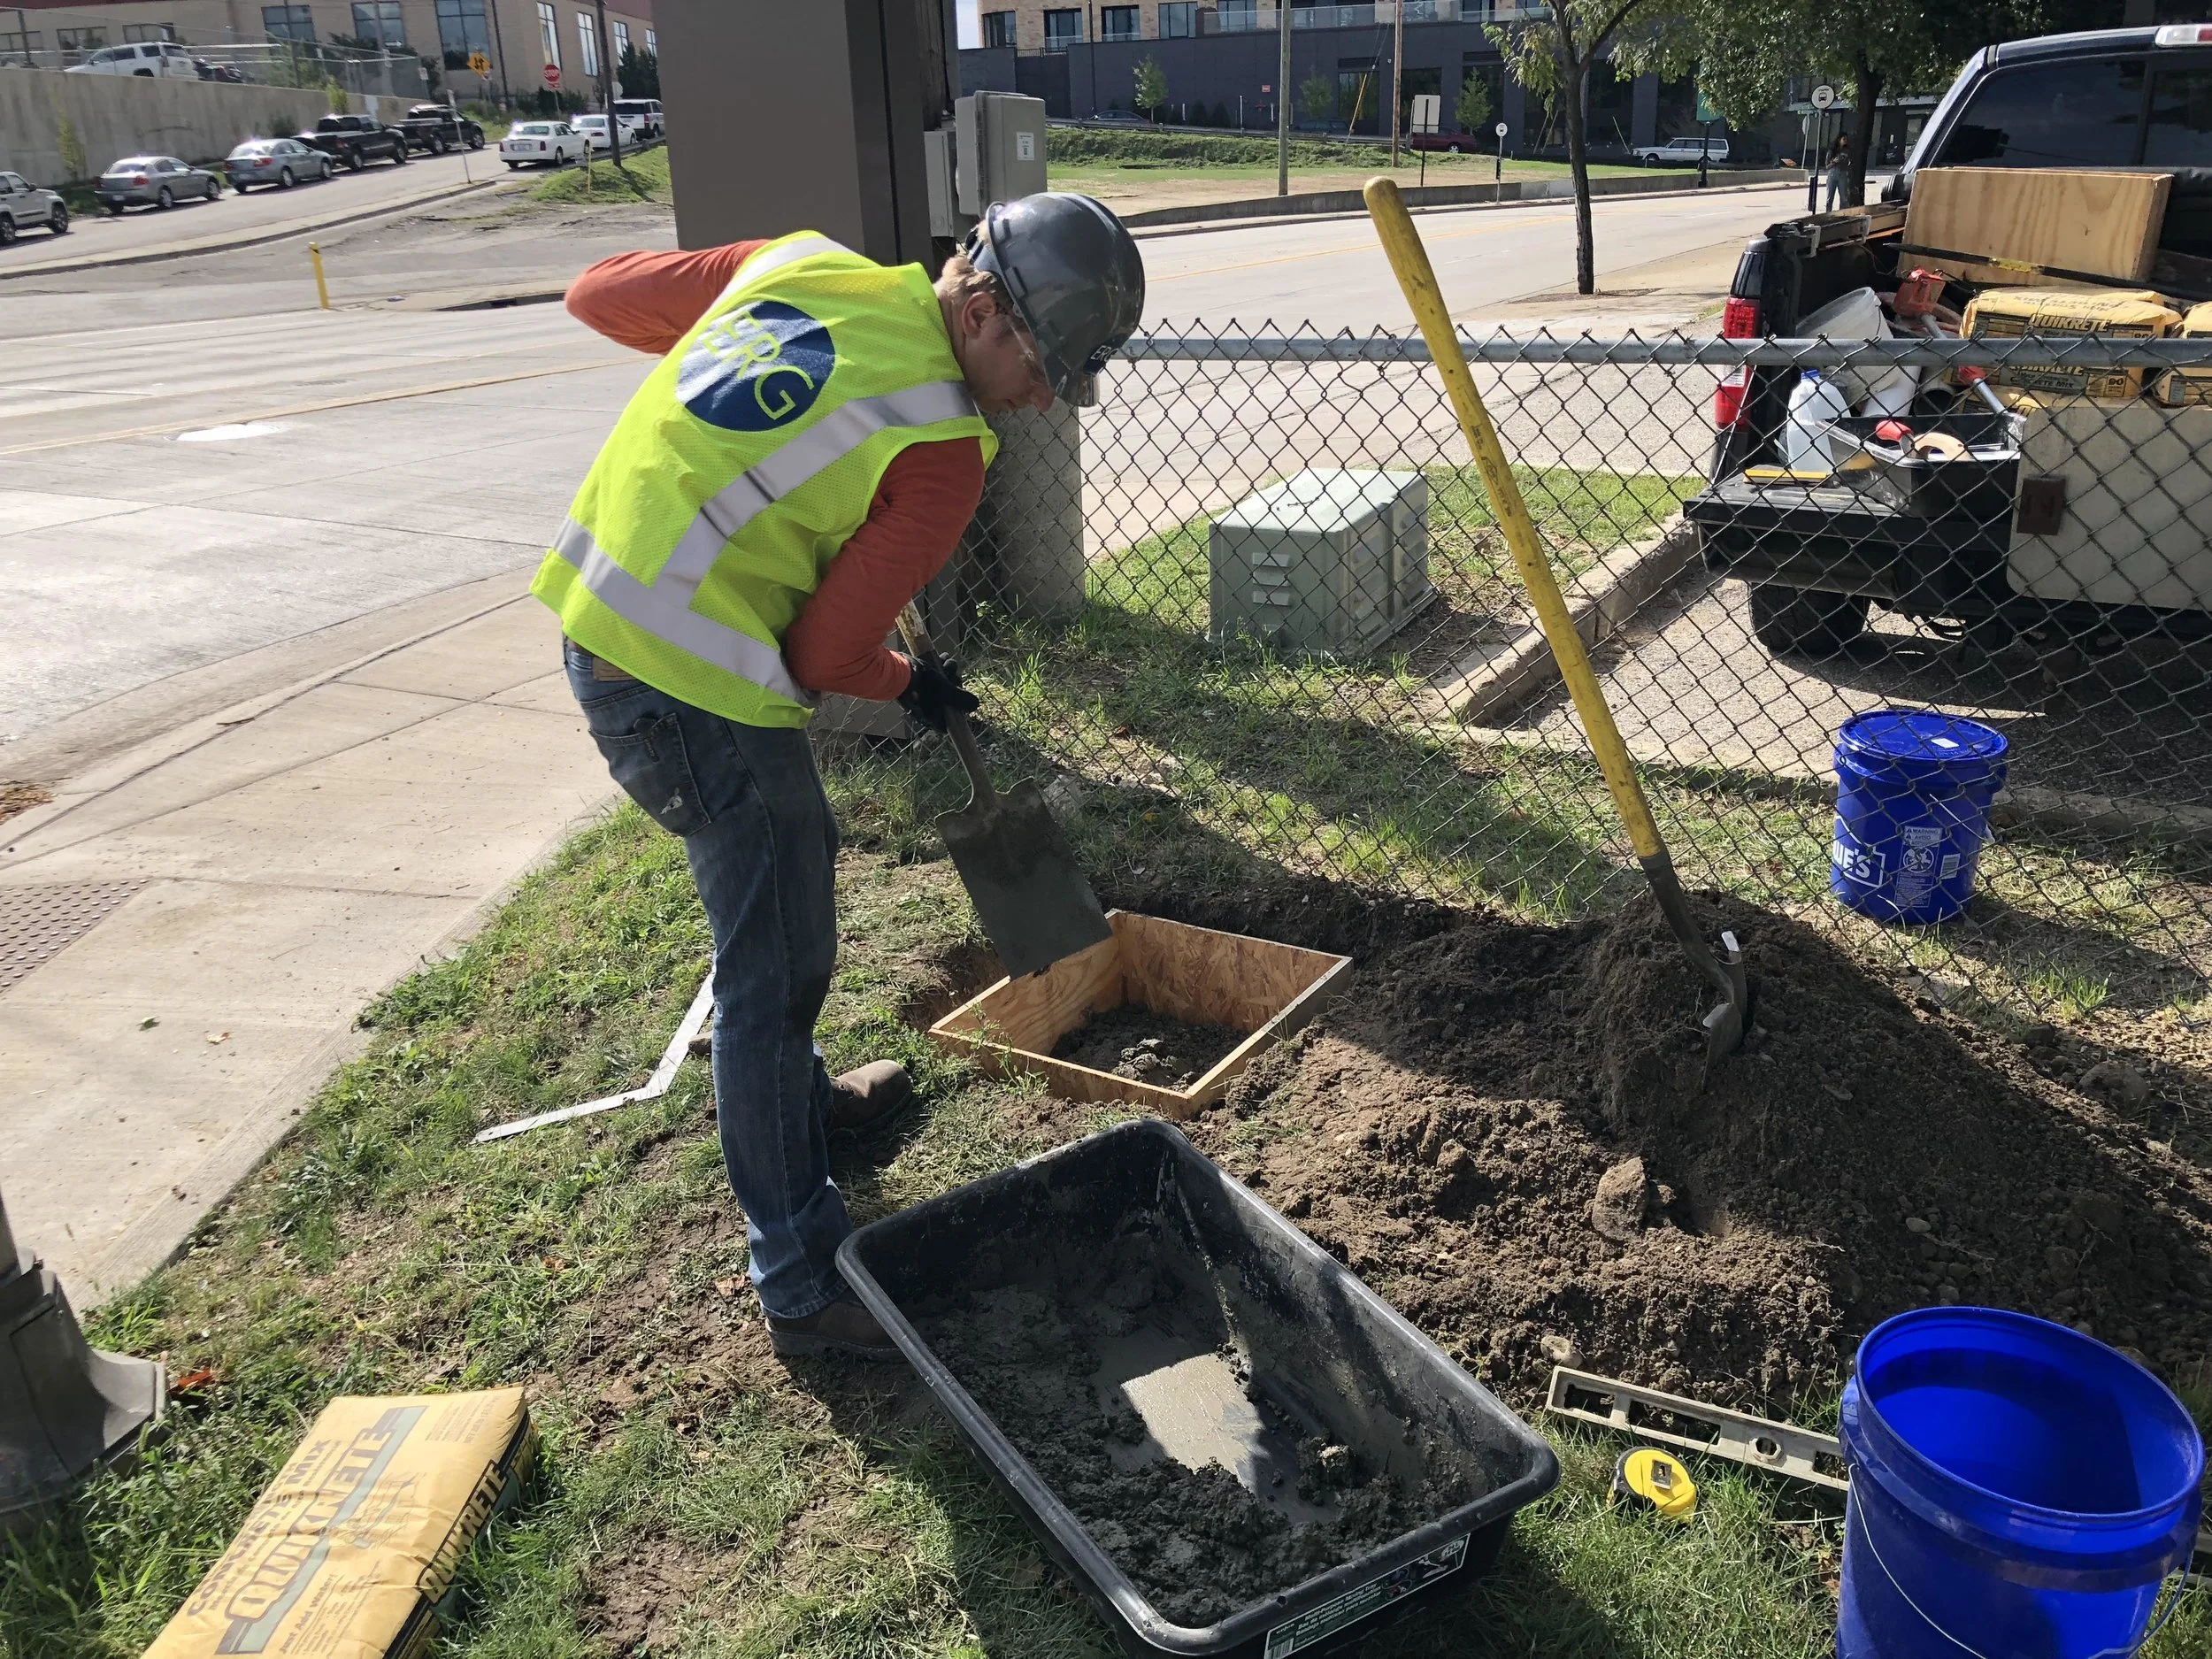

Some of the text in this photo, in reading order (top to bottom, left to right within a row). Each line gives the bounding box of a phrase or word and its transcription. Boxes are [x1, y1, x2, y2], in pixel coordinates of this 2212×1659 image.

[702, 310, 815, 421] ERG
[2028, 313, 2111, 332] QUIKRETE
[1832, 840, 1870, 879] WE'S
[187, 1494, 292, 1617] CONCRETE
[286, 1439, 332, 1485] MIX
[227, 1428, 393, 1620] QUIKRETE
[419, 1462, 508, 1604] QUIKRETE
